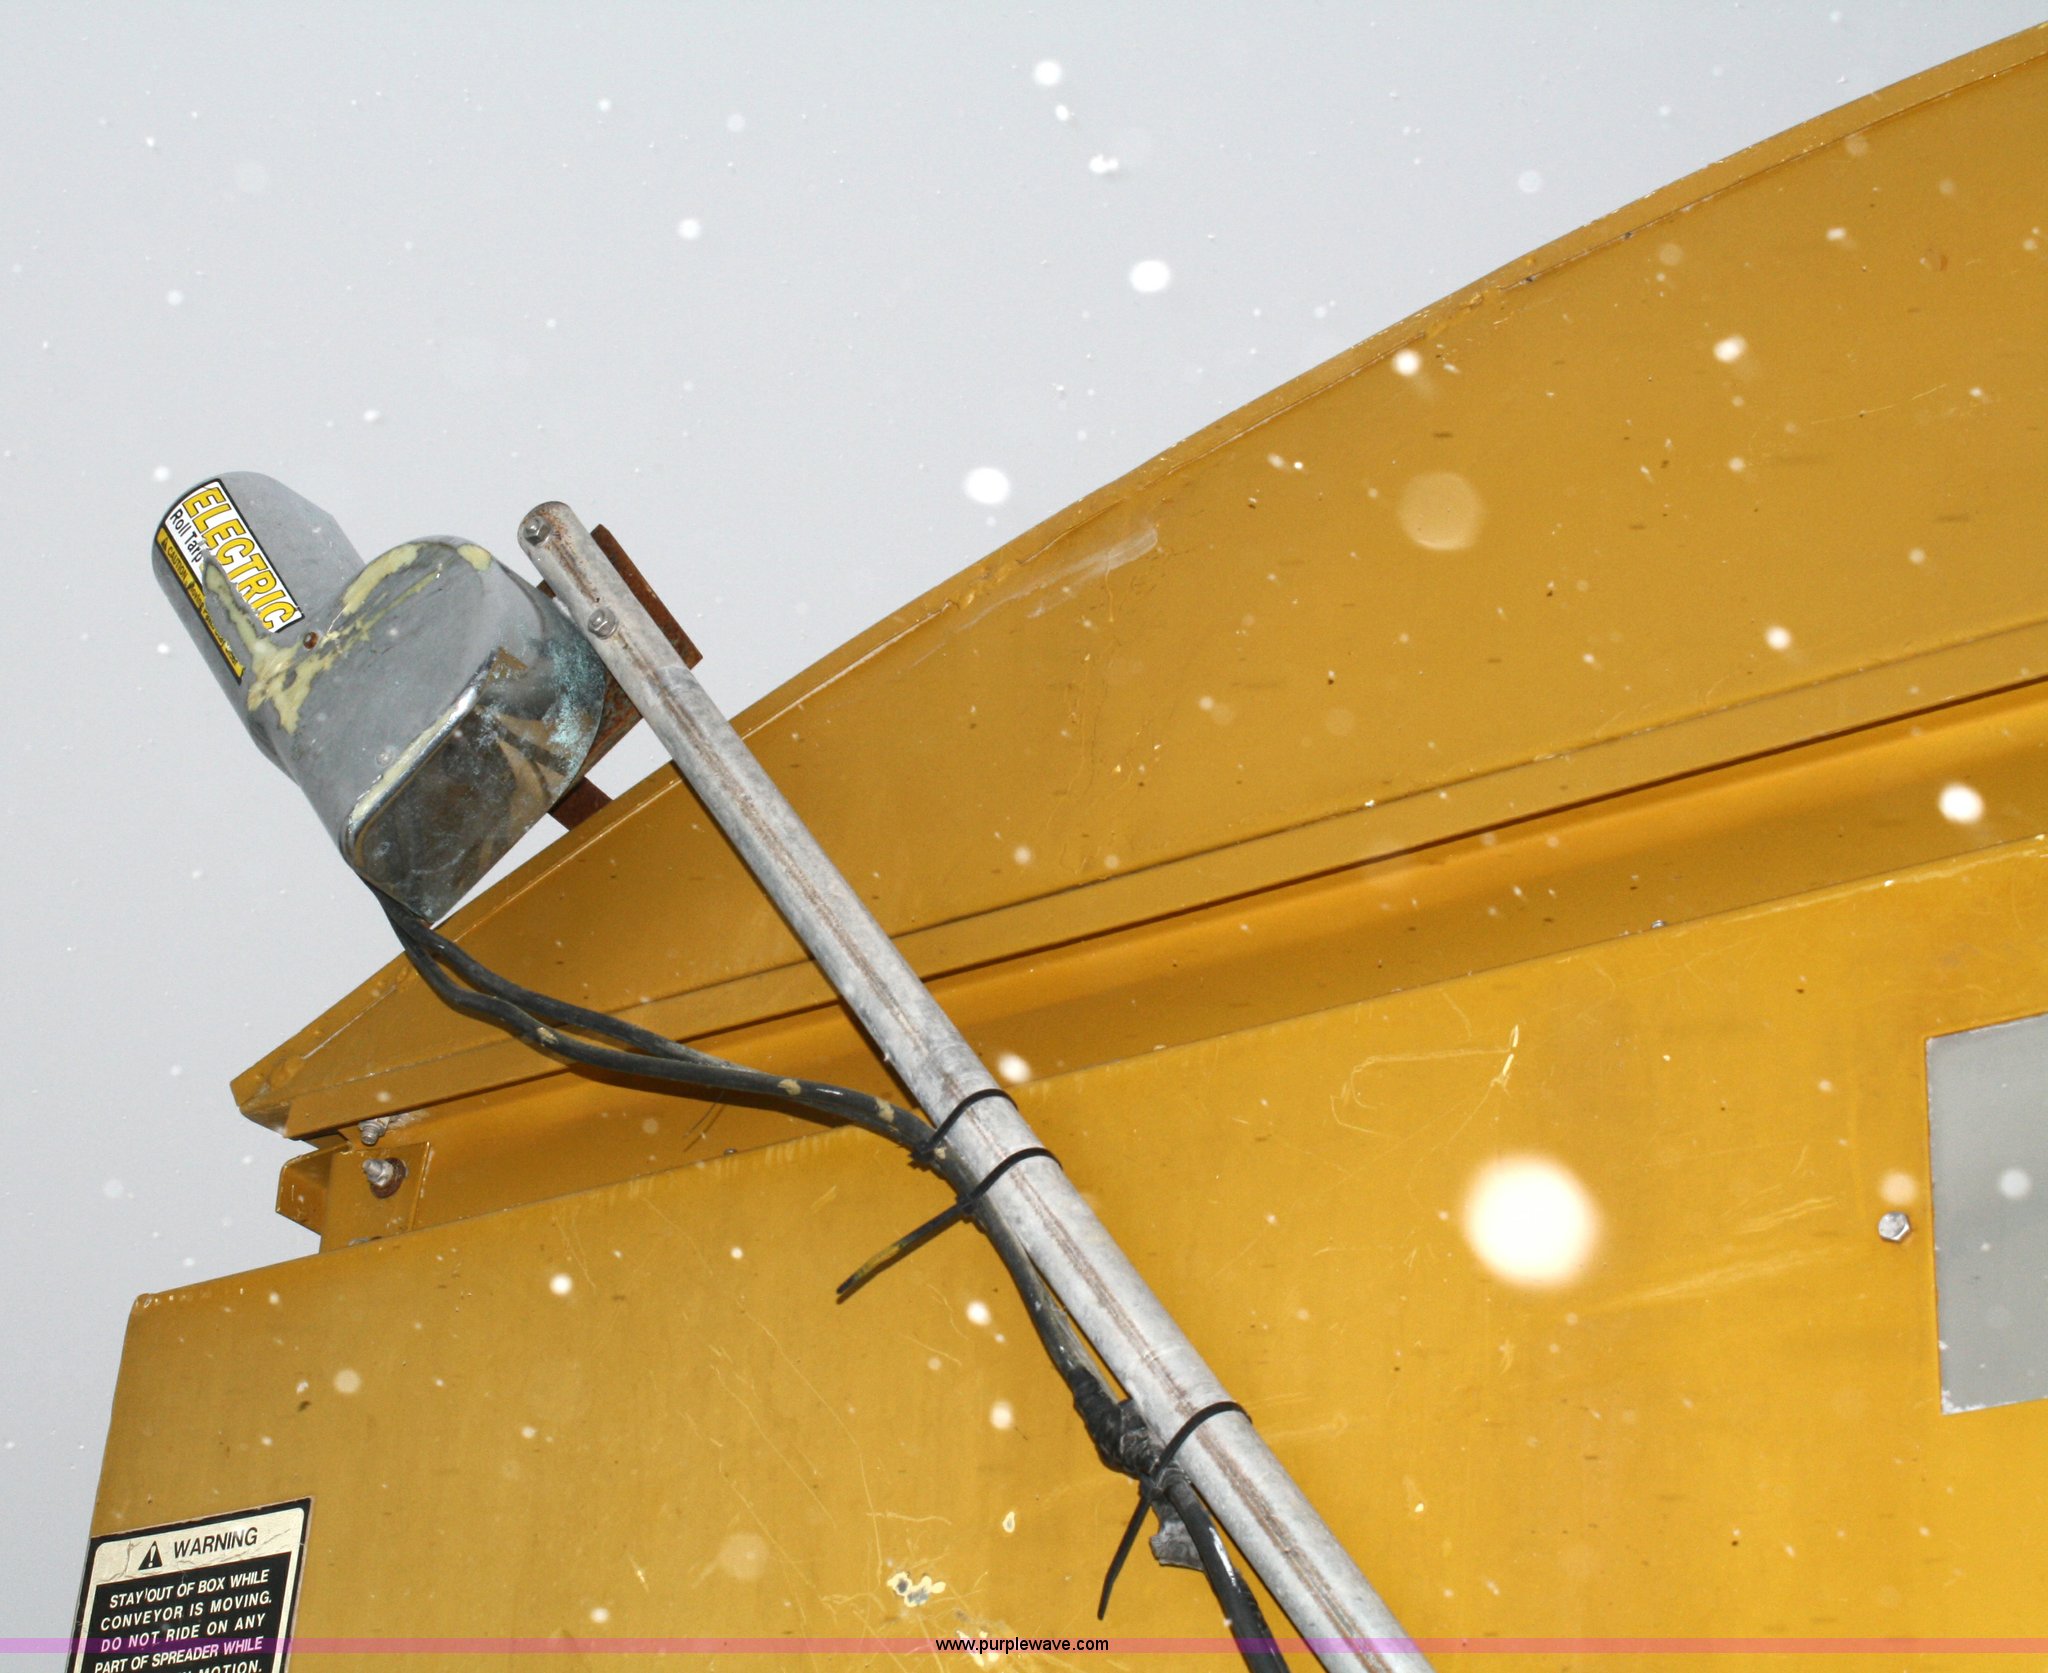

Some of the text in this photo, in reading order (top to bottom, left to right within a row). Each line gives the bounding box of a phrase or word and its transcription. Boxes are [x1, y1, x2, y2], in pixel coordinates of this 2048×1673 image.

[169, 508, 203, 564] Roll Tarp
[167, 545, 188, 582] CAUTION
[182, 486, 297, 630] ELECTRIC
[174, 1526, 258, 1559] WARNING
[109, 1569, 270, 1609] STAY OUT OF BOX WHILE
[100, 1590, 272, 1631] CONVEYOR IS MOVING.
[101, 1612, 266, 1653] DO NOT RIDE ON ANY
[94, 1636, 263, 1673] PART OF SPREADER WHILE
